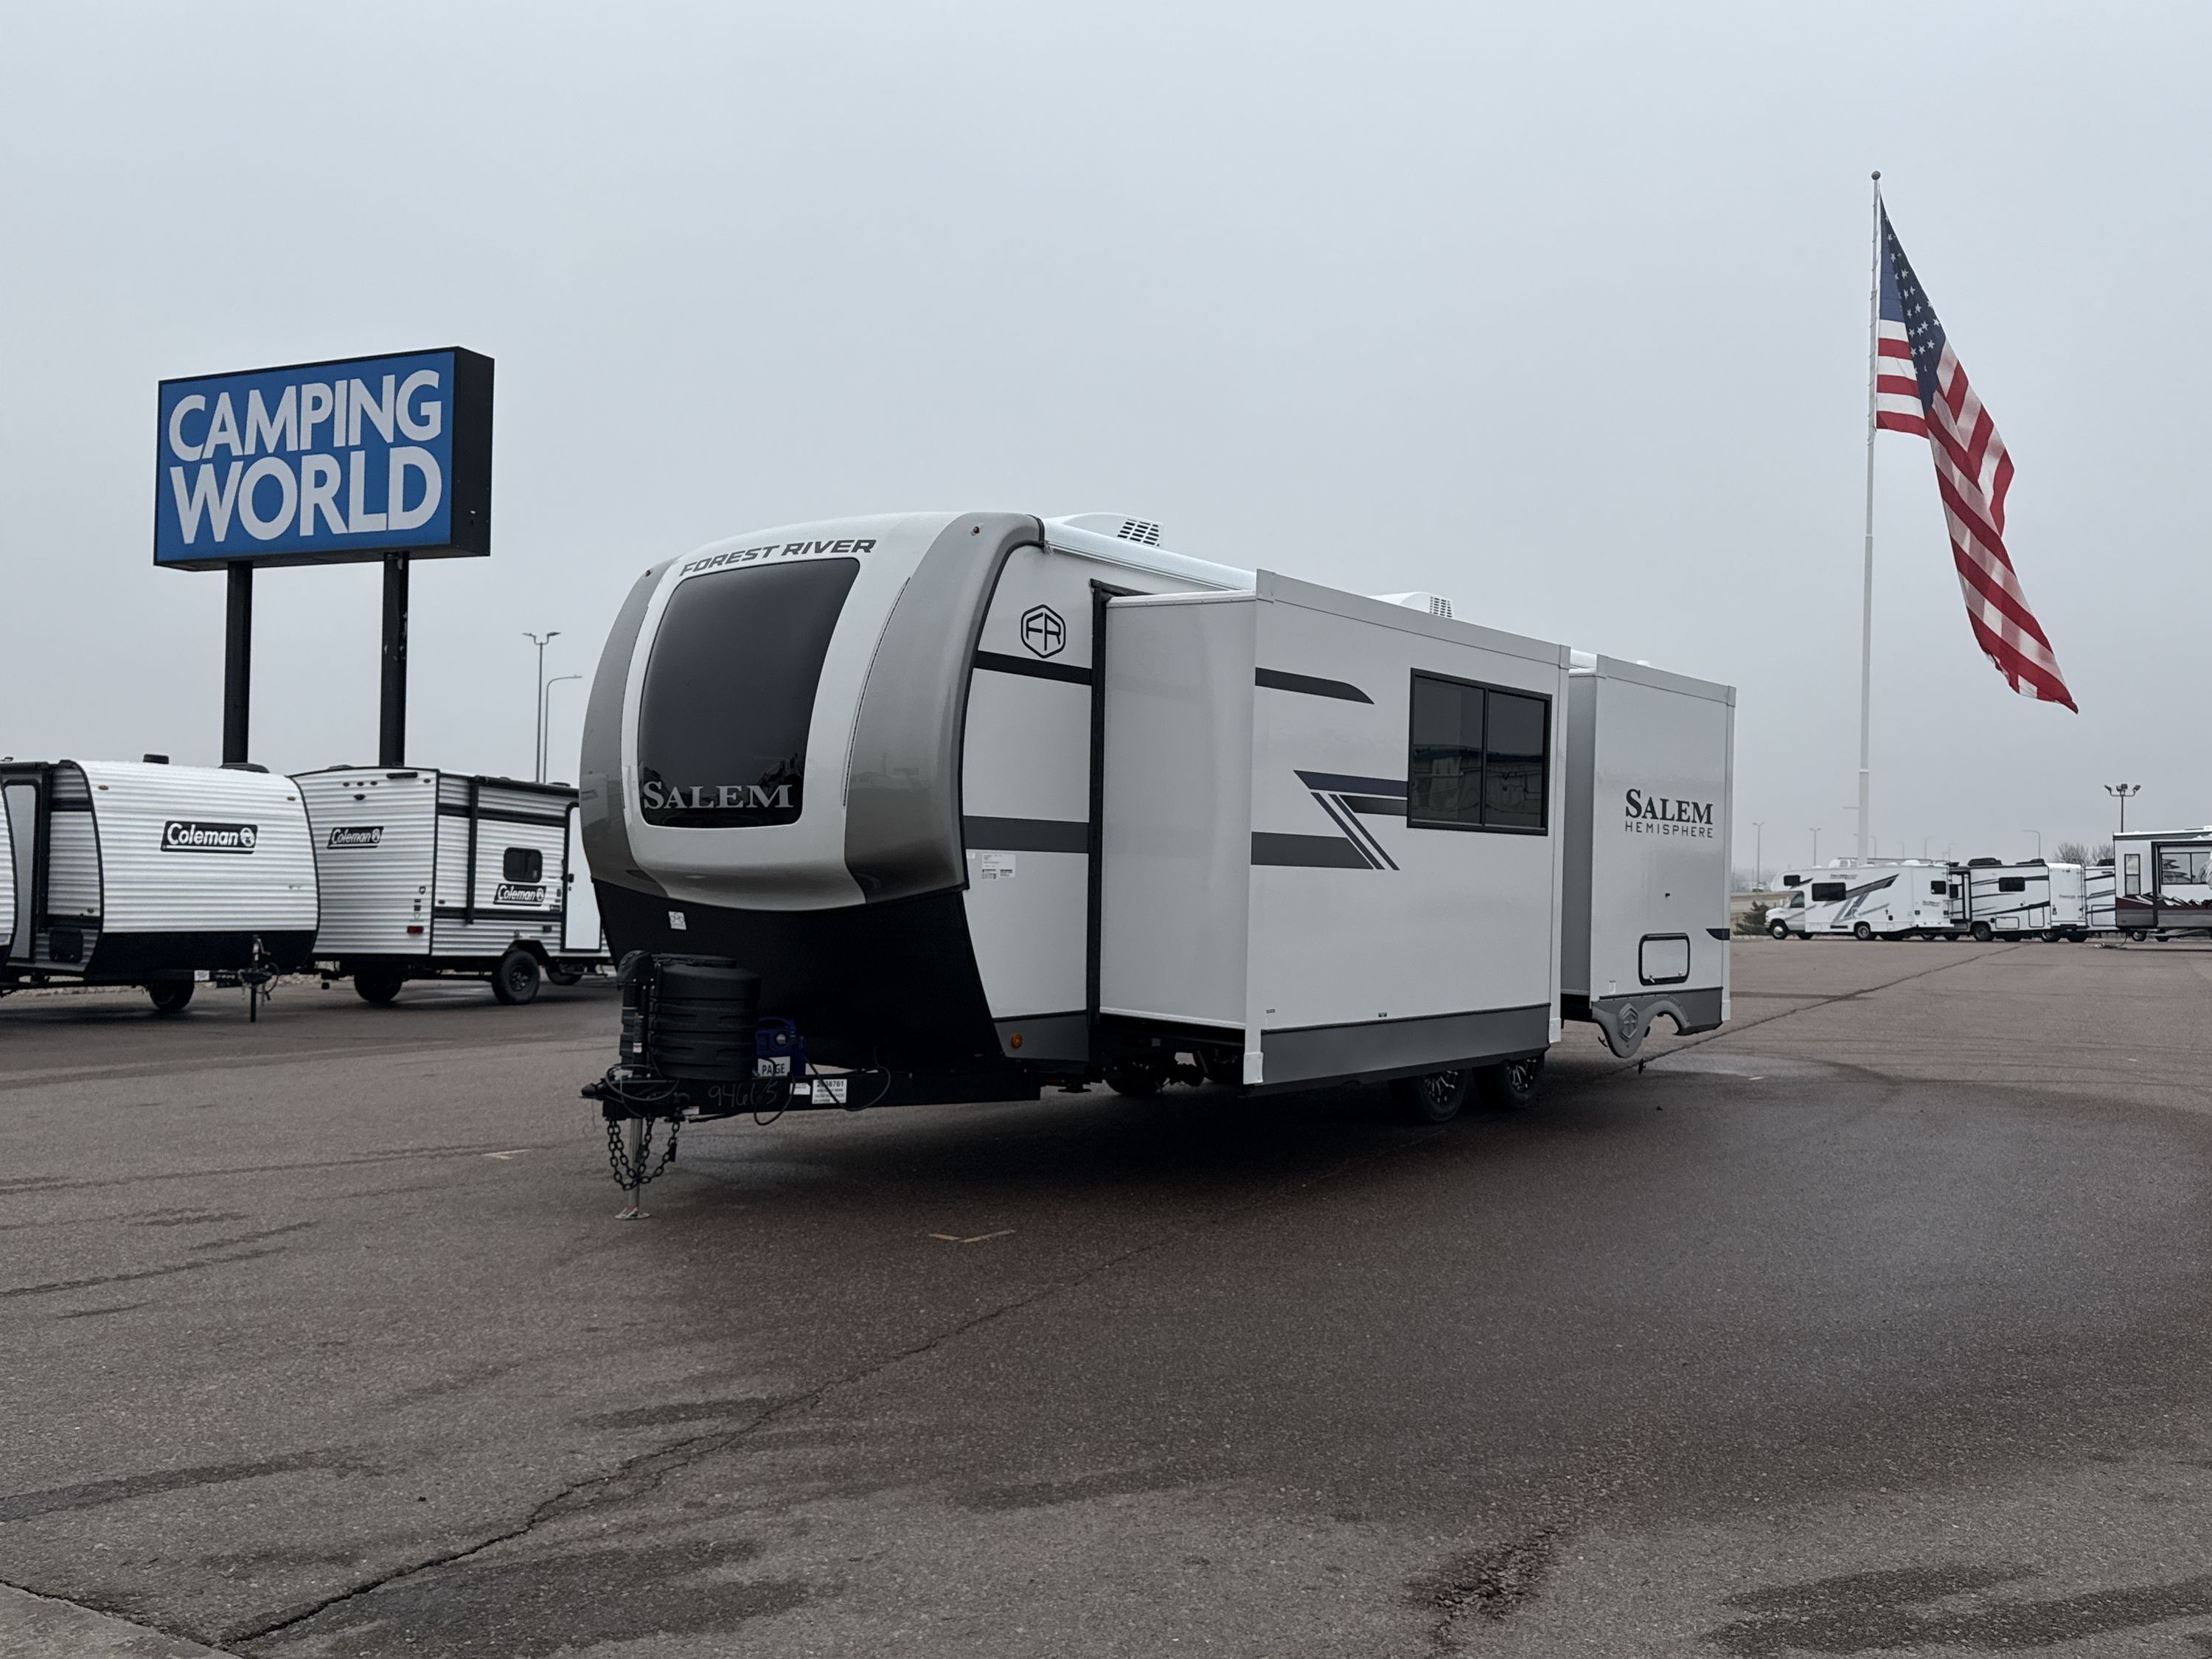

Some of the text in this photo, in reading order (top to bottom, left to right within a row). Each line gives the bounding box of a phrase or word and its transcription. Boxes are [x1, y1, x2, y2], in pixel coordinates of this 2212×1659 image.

[169, 369, 442, 462] CAMPING
[170, 445, 442, 544] WORLD
[679, 539, 877, 577] FOREST RIVER
[643, 781, 794, 810] SALEM
[1625, 788, 1714, 825] SALEM
[167, 823, 240, 846] Coleman
[331, 827, 372, 844] Coleman
[1625, 820, 1714, 838] HEMISPHERE
[497, 884, 536, 901] Coleman
[762, 1063, 785, 1075] PAGE
